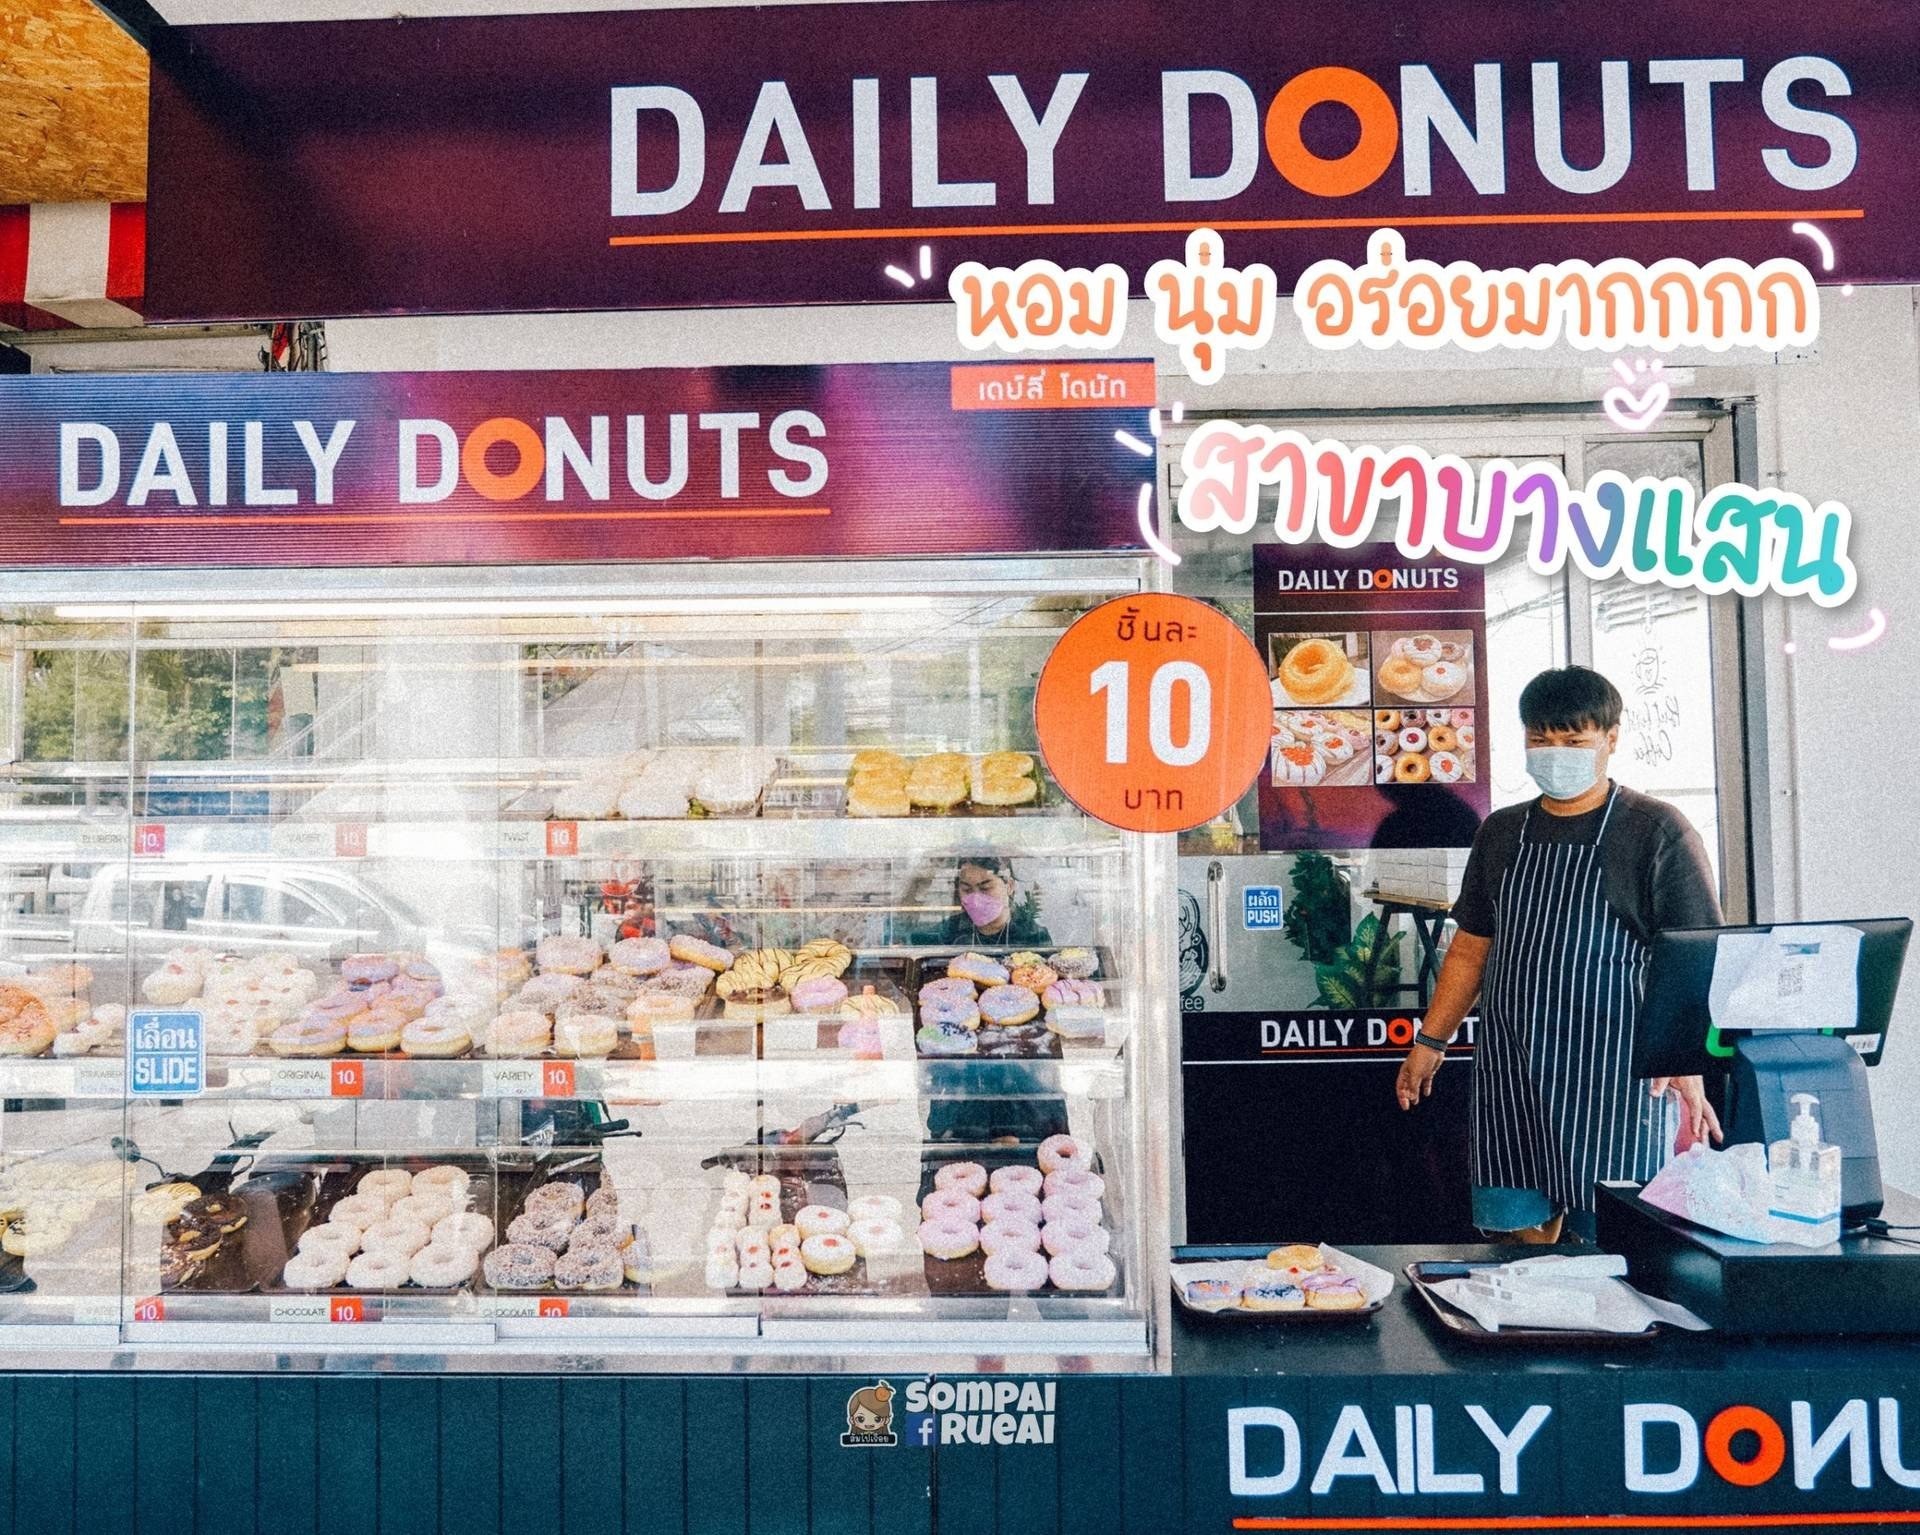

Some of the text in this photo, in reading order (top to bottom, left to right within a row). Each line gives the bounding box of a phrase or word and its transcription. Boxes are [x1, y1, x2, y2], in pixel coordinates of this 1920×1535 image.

[610, 56, 1859, 217] DAILY DONUTS
[59, 409, 830, 508] DAILY DONUTS
[1278, 567, 1460, 591] DAILY DONUTS
[1089, 660, 1212, 768] 10
[1124, 789, 1183, 811] บาท
[1247, 891, 1278, 907] ผลัก
[1247, 909, 1279, 924] PUSH
[135, 1018, 199, 1051] เลื่อน
[1260, 1019, 1354, 1048] DAILY
[135, 1056, 198, 1085] SLIDE
[277, 1070, 326, 1081] ORIGINAL
[337, 1069, 358, 1085] 10.
[494, 1070, 534, 1081] VARIETY
[547, 1069, 569, 1085] 10.
[274, 1306, 326, 1318] CHOCOLATE
[1227, 1404, 1552, 1496] DAILY
